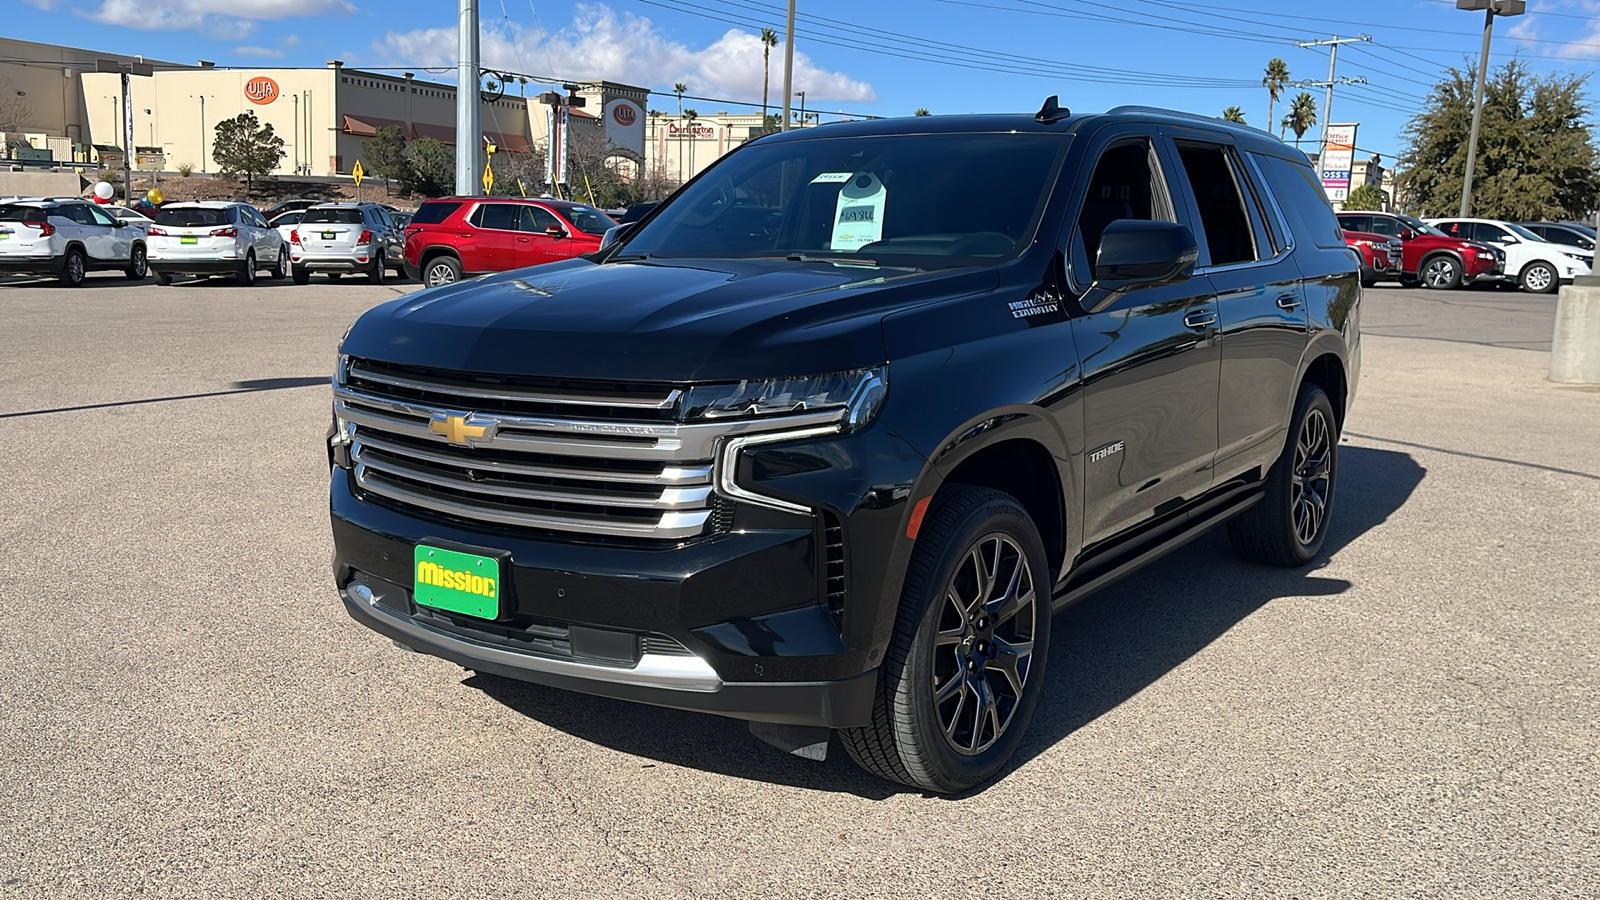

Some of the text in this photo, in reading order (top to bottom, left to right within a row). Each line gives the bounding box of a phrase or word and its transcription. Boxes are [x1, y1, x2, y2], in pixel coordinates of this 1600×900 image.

[249, 81, 274, 94] ULTA
[618, 107, 634, 120] ULTA
[669, 123, 714, 136] Burlngton
[1323, 171, 1342, 179] OSS
[1008, 299, 1035, 311] HIGH
[1012, 304, 1058, 318] COUNTRY
[1089, 440, 1125, 463] TAHOE
